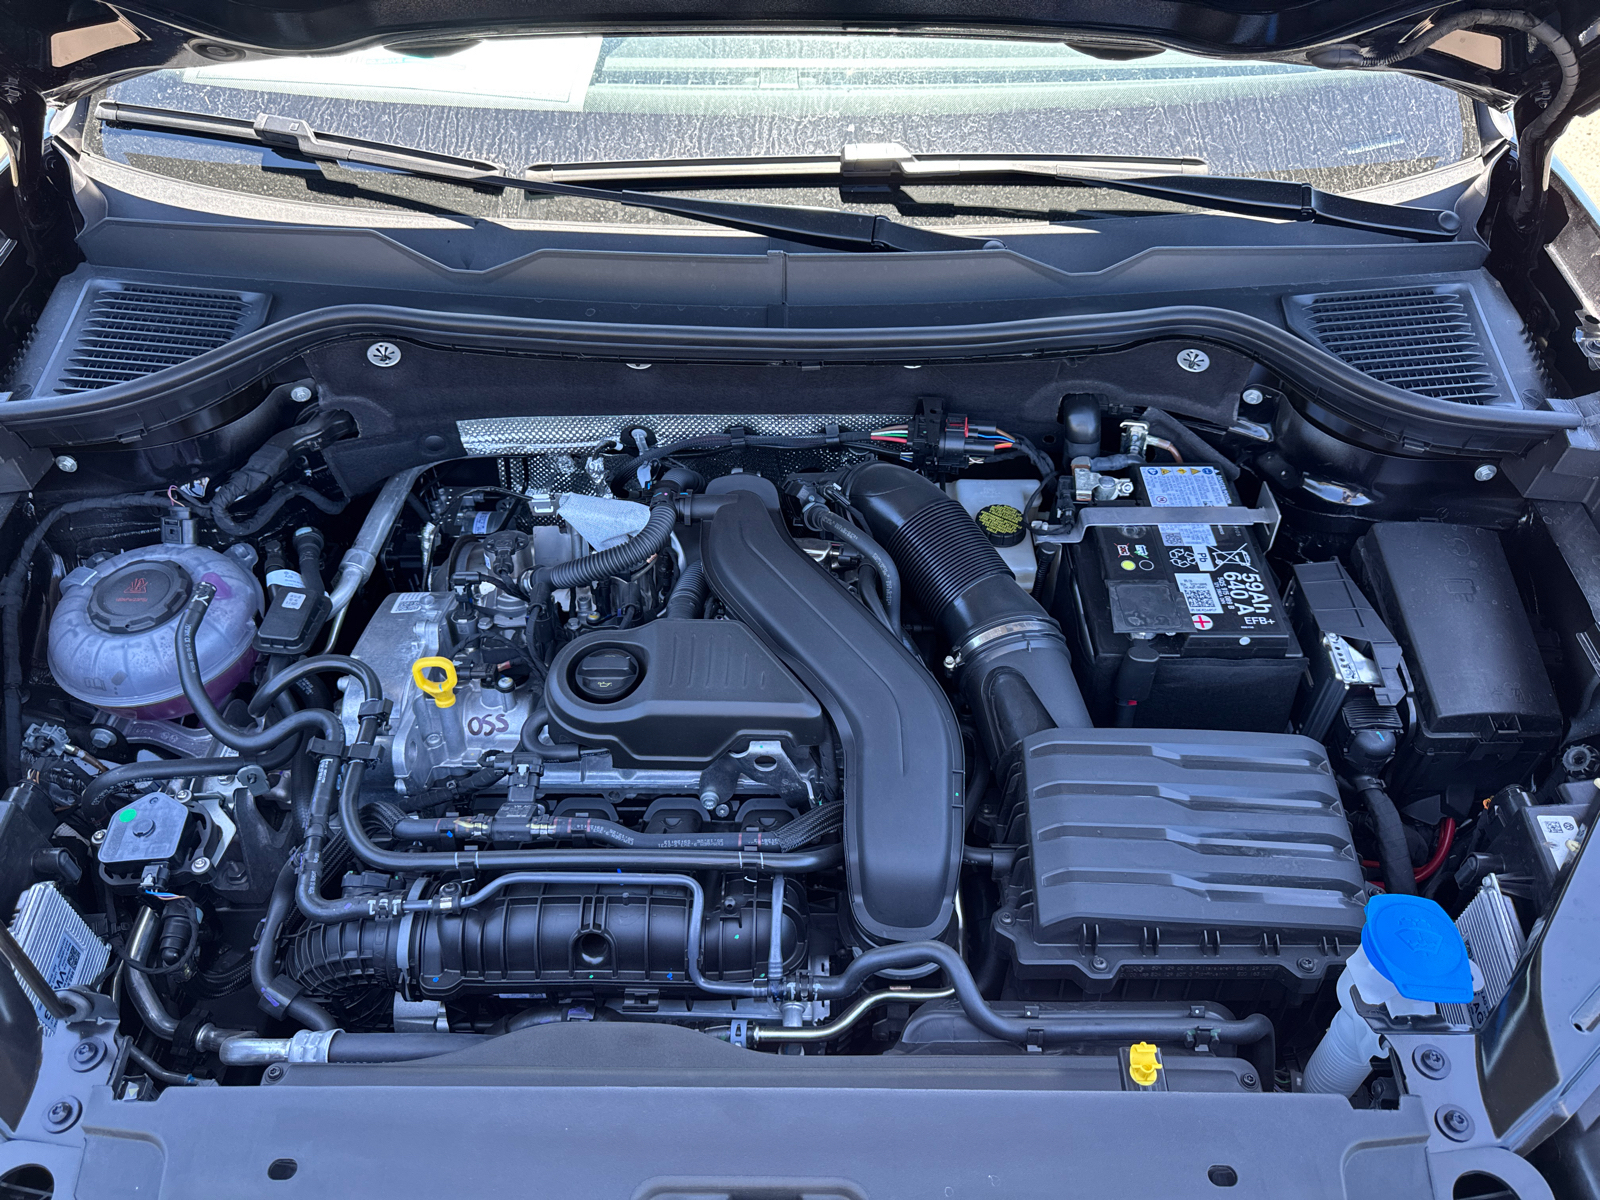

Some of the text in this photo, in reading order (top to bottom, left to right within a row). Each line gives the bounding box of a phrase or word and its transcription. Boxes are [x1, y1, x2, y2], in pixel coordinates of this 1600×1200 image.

[1196, 552, 1208, 563] Pb
[1223, 571, 1250, 600] 640
[1241, 572, 1273, 614] 59Ah
[1234, 602, 1255, 616] A
[1244, 616, 1276, 625] EFB+
[1473, 1003, 1484, 1024] AG
